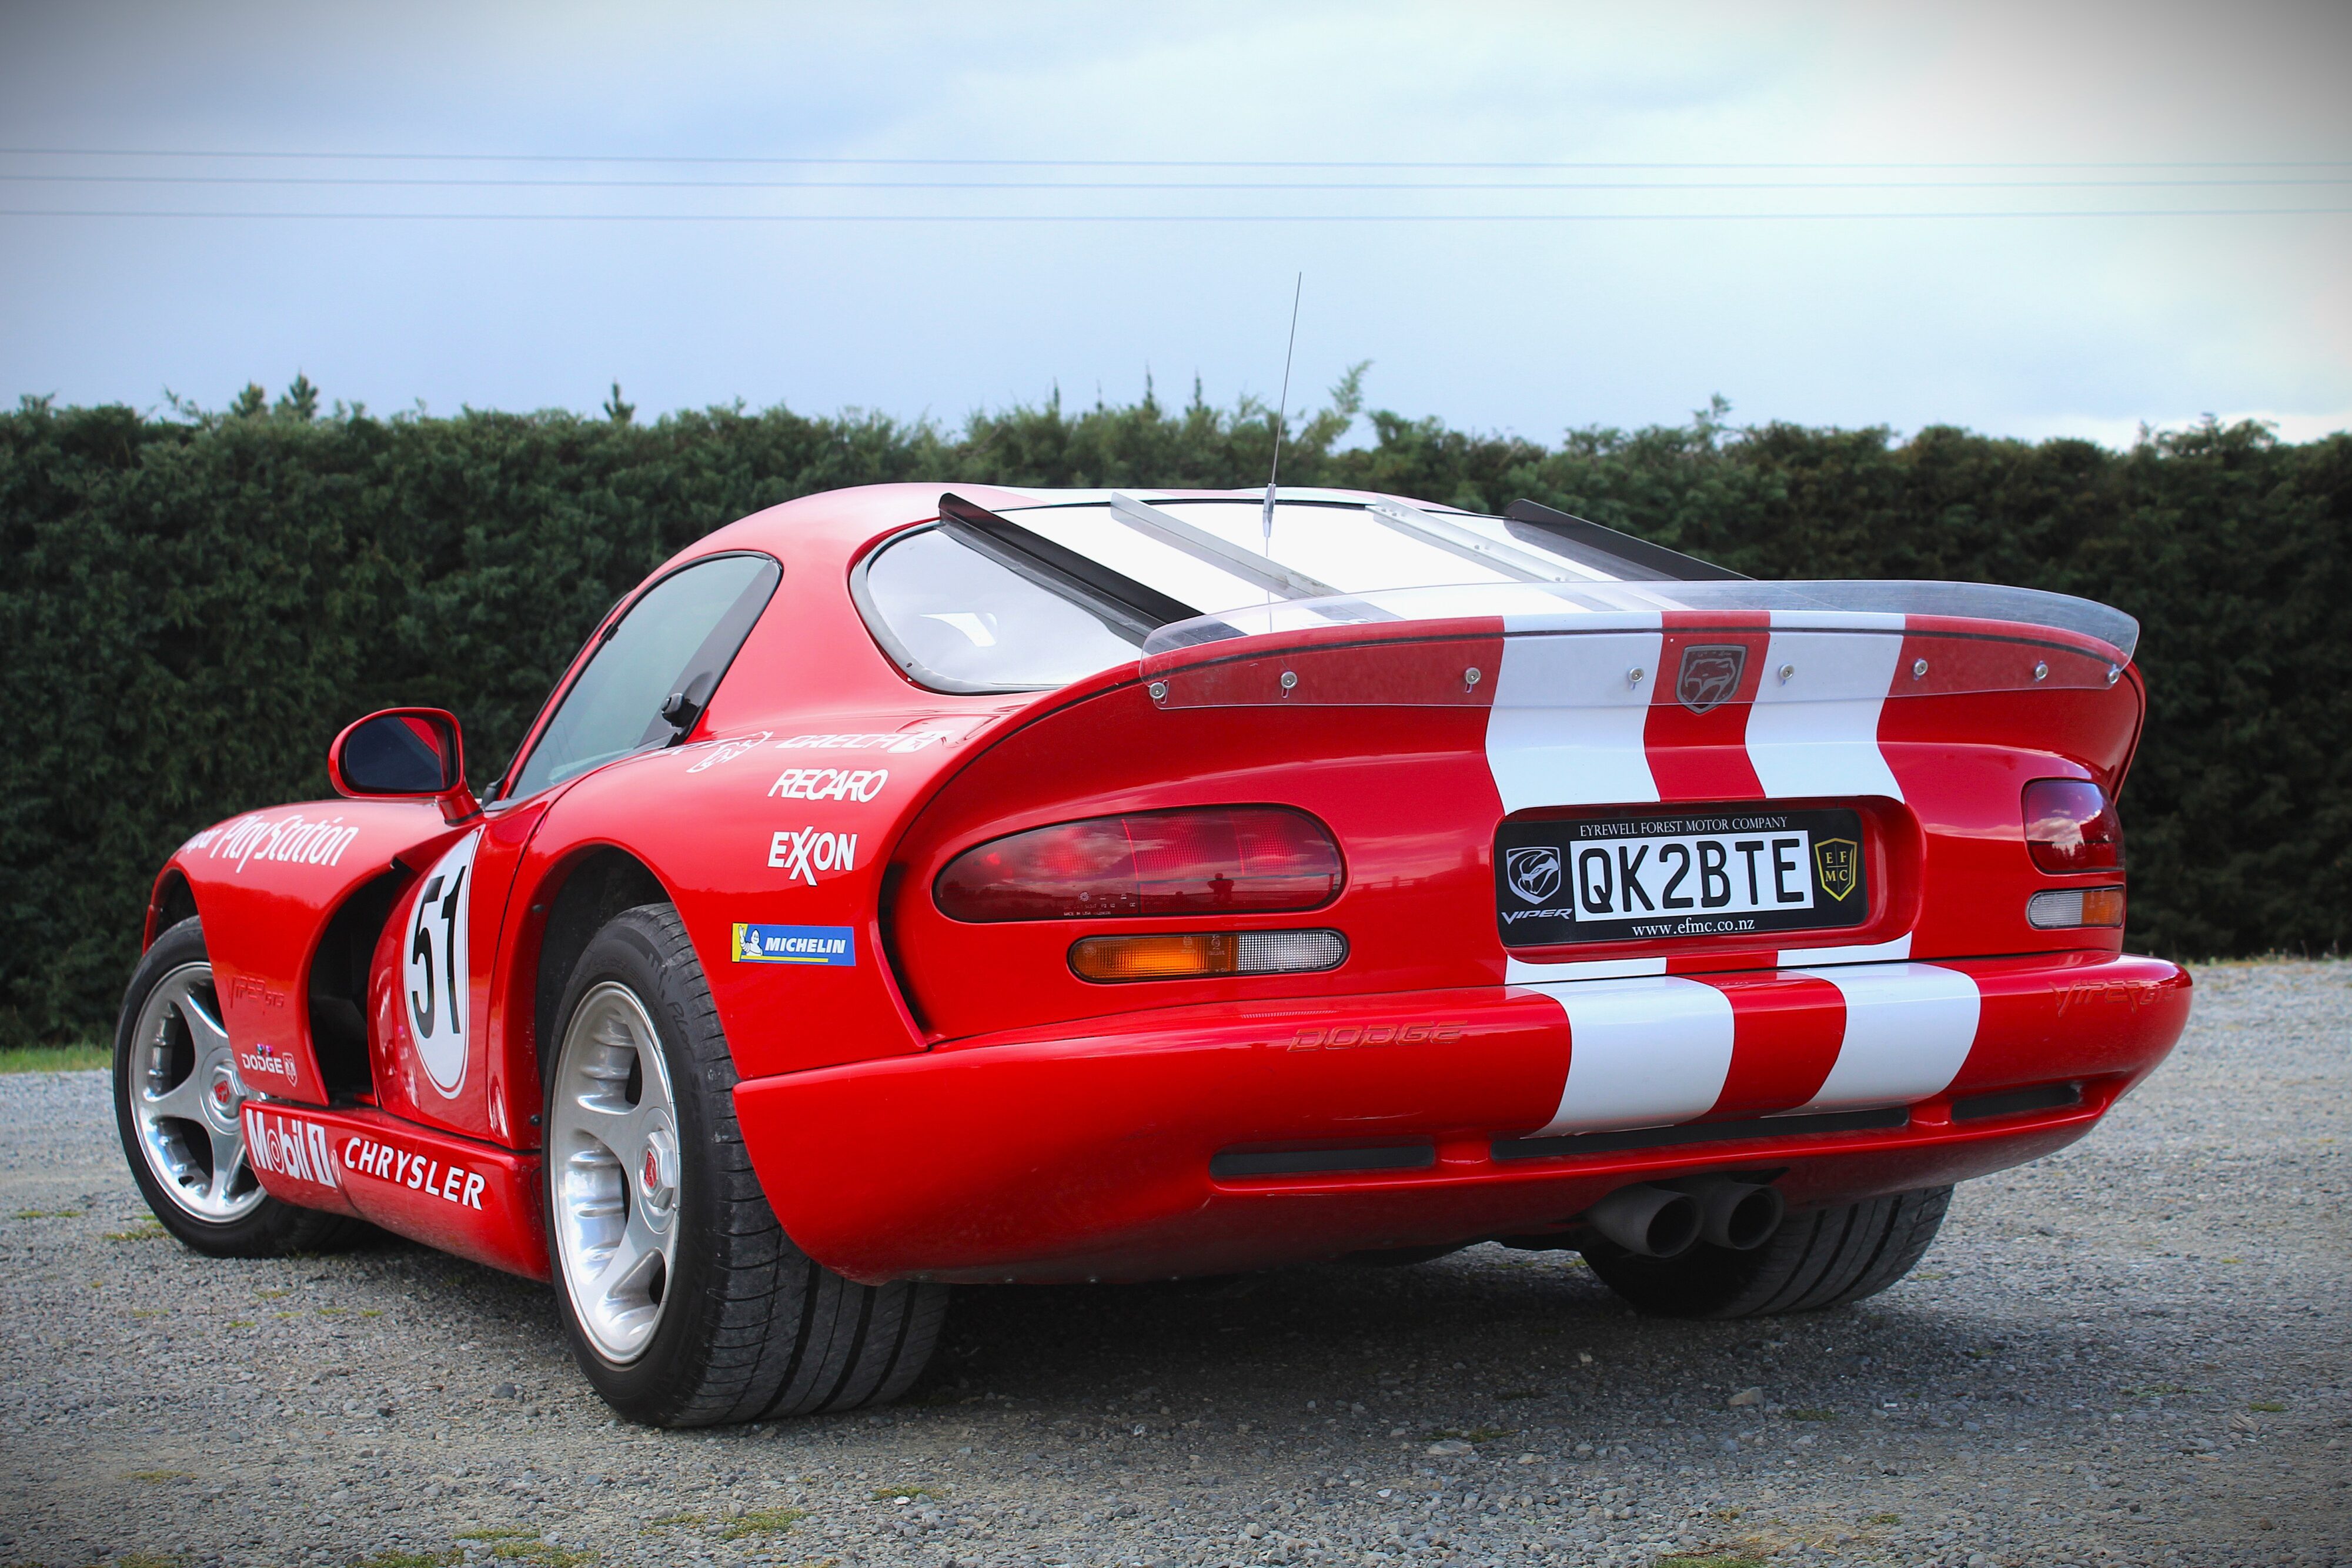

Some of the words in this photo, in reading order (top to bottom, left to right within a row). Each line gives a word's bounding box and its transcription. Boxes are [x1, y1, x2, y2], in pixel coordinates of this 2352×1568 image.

[767, 769, 888, 803] RECARO
[209, 815, 359, 873] PlayStation
[1580, 823, 1638, 837] EYREWELL
[1641, 821, 1682, 833] FOREST
[1686, 819, 1729, 831] MOTOR
[1732, 817, 1787, 830] COMPANY
[767, 826, 857, 886] EXXON
[1579, 839, 1804, 913] QK2BTE
[1501, 908, 1573, 925] VIPER
[1632, 917, 1755, 937] www.efmc.co.nz
[412, 865, 467, 1039] 51
[764, 937, 846, 954] MICHELIN
[1286, 1019, 1468, 1052] DODGE
[241, 1052, 285, 1075] DODGE
[246, 1108, 315, 1182] Mobil
[344, 1136, 486, 1211] CHRYSLER
